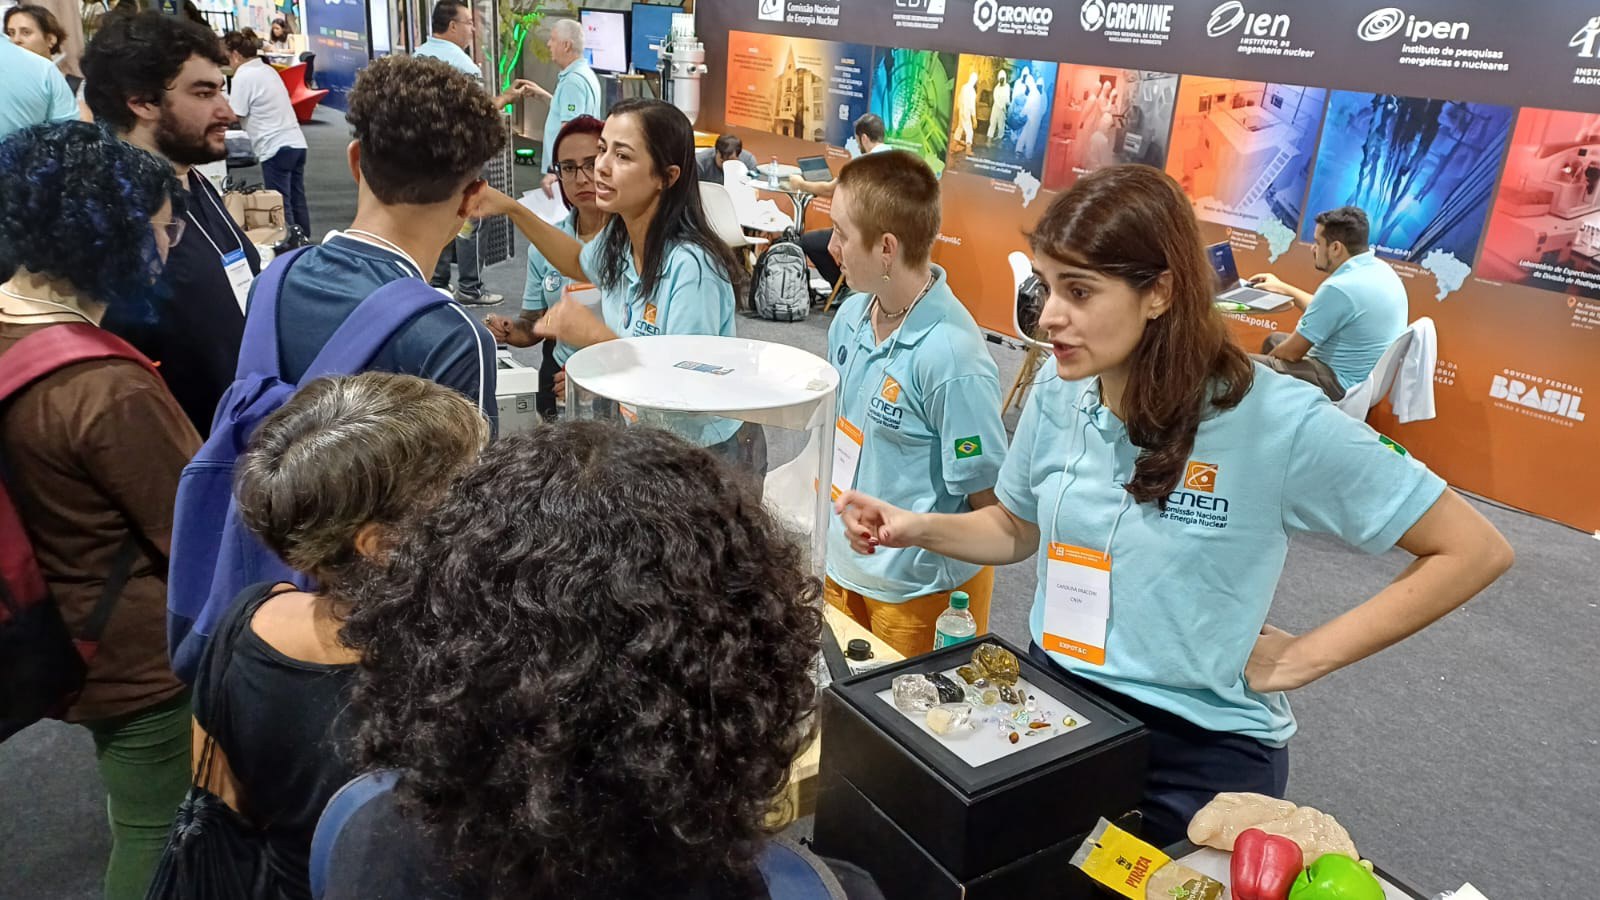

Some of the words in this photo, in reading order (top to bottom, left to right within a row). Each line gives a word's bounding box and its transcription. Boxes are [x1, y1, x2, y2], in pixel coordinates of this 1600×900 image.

[814, 4, 840, 15] Nacional
[786, 13, 794, 22] de
[795, 13, 816, 26] Energia
[816, 15, 839, 26] Nuclear
[1405, 15, 1470, 42] ipen
[1240, 38, 1278, 46] INSTITUTO
[1237, 45, 1282, 55] engenharia
[1283, 47, 1315, 58] nuclear
[1441, 46, 1454, 56] de
[1455, 48, 1504, 59] pesquisas
[1399, 56, 1452, 67] energéticas
[1453, 60, 1460, 68] e
[1462, 60, 1509, 71] nucleares
[1436, 367, 1456, 378] OGIA
[1503, 368, 1543, 383] GOVERNO
[1545, 379, 1584, 394] FEDERAL
[1489, 374, 1585, 422] BRASIL
[1160, 511, 1168, 519] de
[1170, 513, 1197, 525] Energia
[1199, 519, 1228, 528] Nuclear
[1165, 506, 1195, 516] omissão
[1196, 510, 1228, 521] Nacional
[1124, 855, 1153, 889] PIRATA
